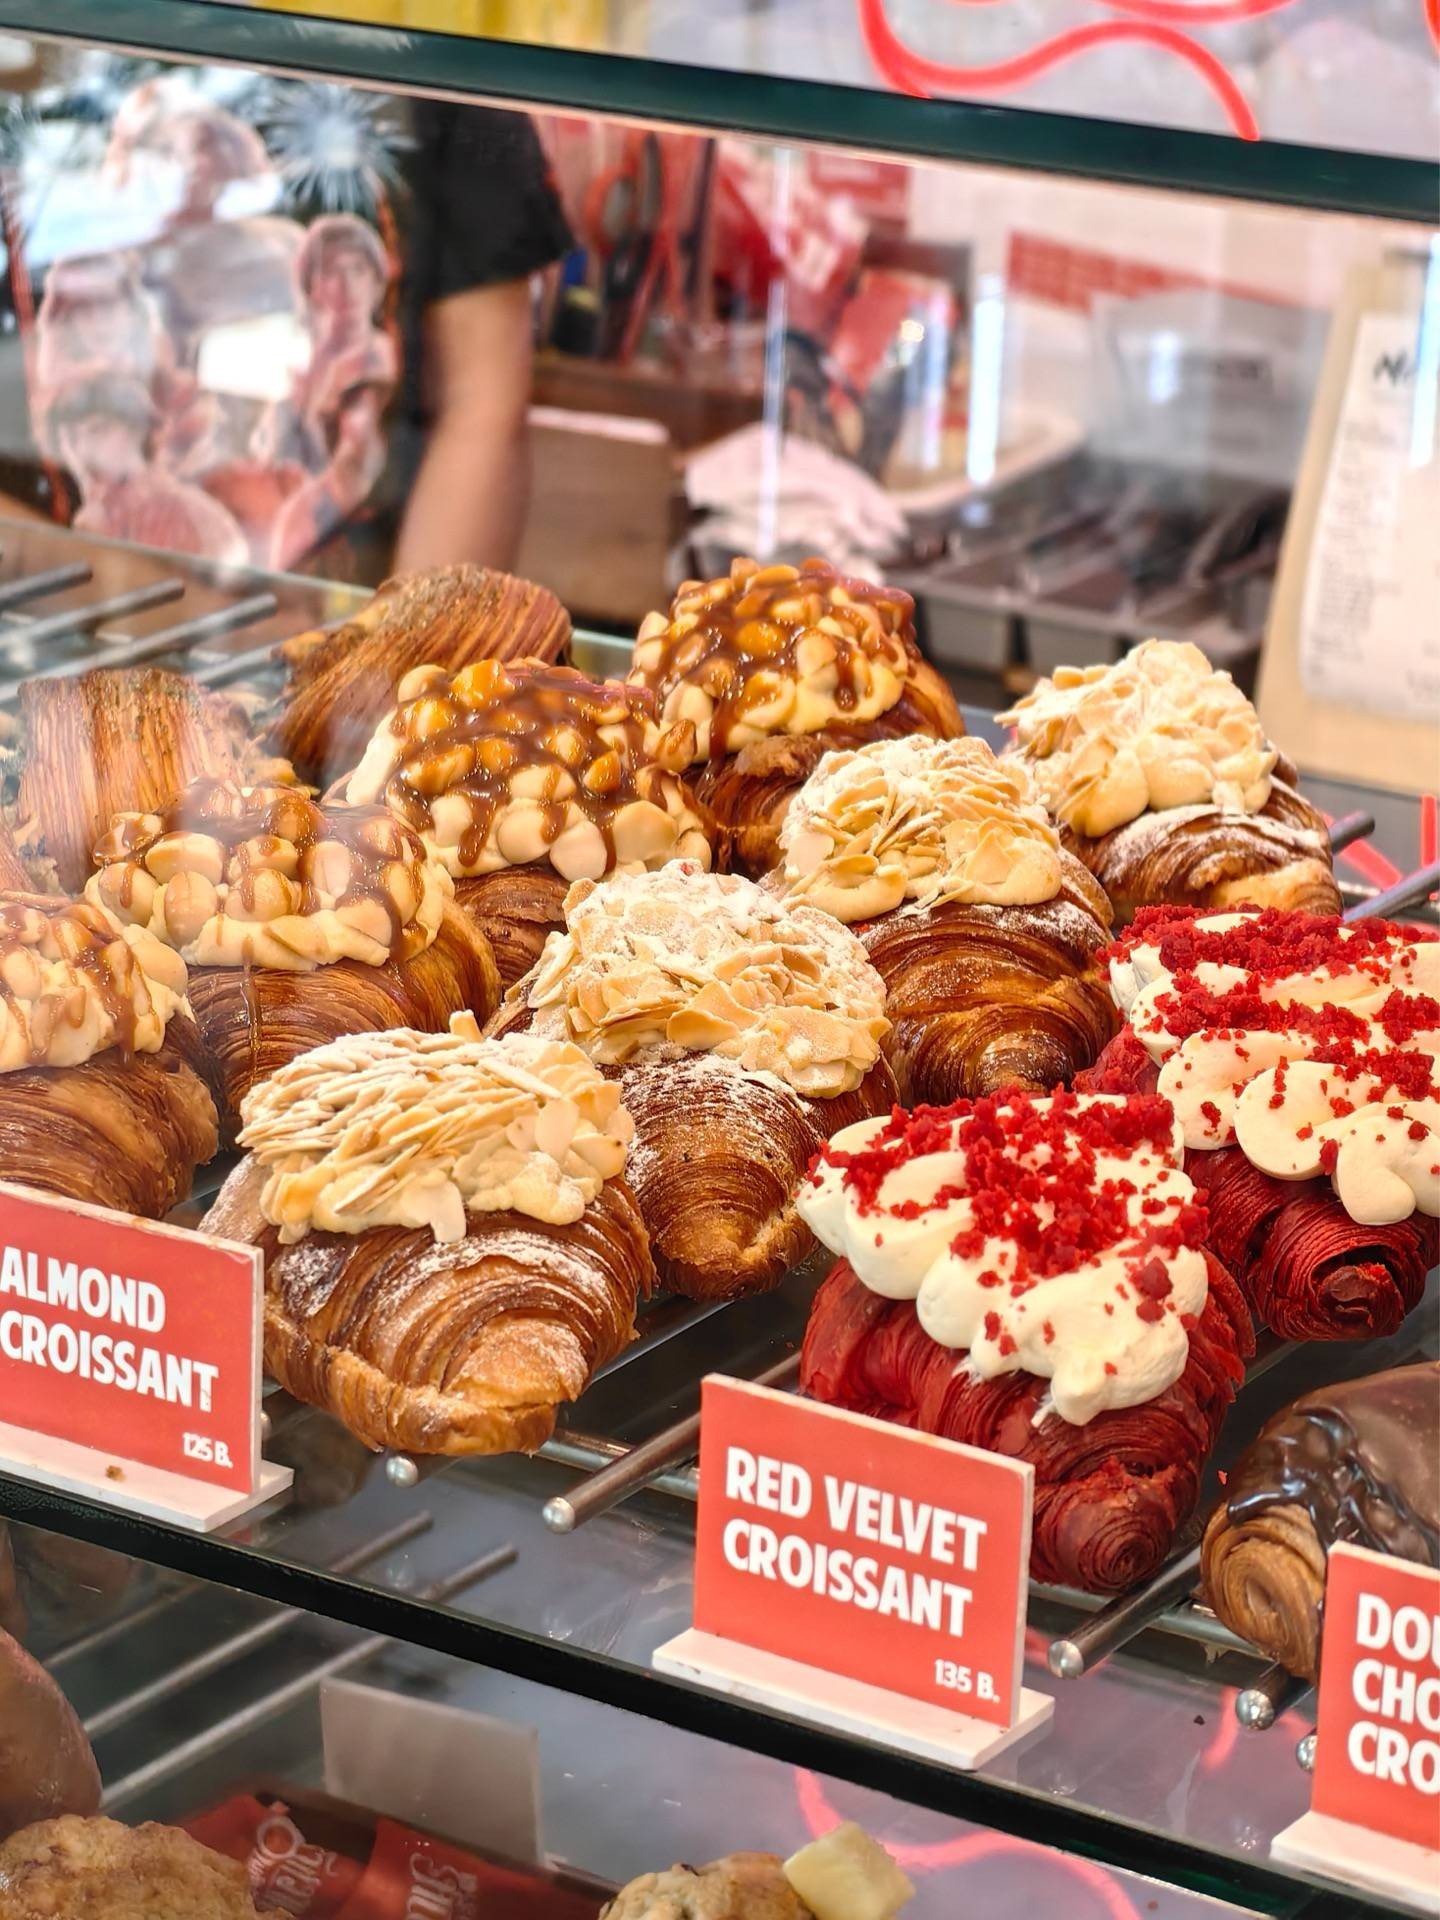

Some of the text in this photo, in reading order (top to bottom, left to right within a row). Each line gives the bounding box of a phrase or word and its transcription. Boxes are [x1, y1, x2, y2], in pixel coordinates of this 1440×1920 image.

[0, 1246, 166, 1333] ALMOND
[0, 1310, 219, 1413] CROISSANT
[182, 1432, 213, 1462] 125
[726, 1446, 987, 1571] RED VELVET
[723, 1518, 972, 1638] CROISSANT
[1356, 1592, 1440, 1669] DO
[935, 1659, 1000, 1703] 135 B.
[1348, 1720, 1440, 1794] CRO
